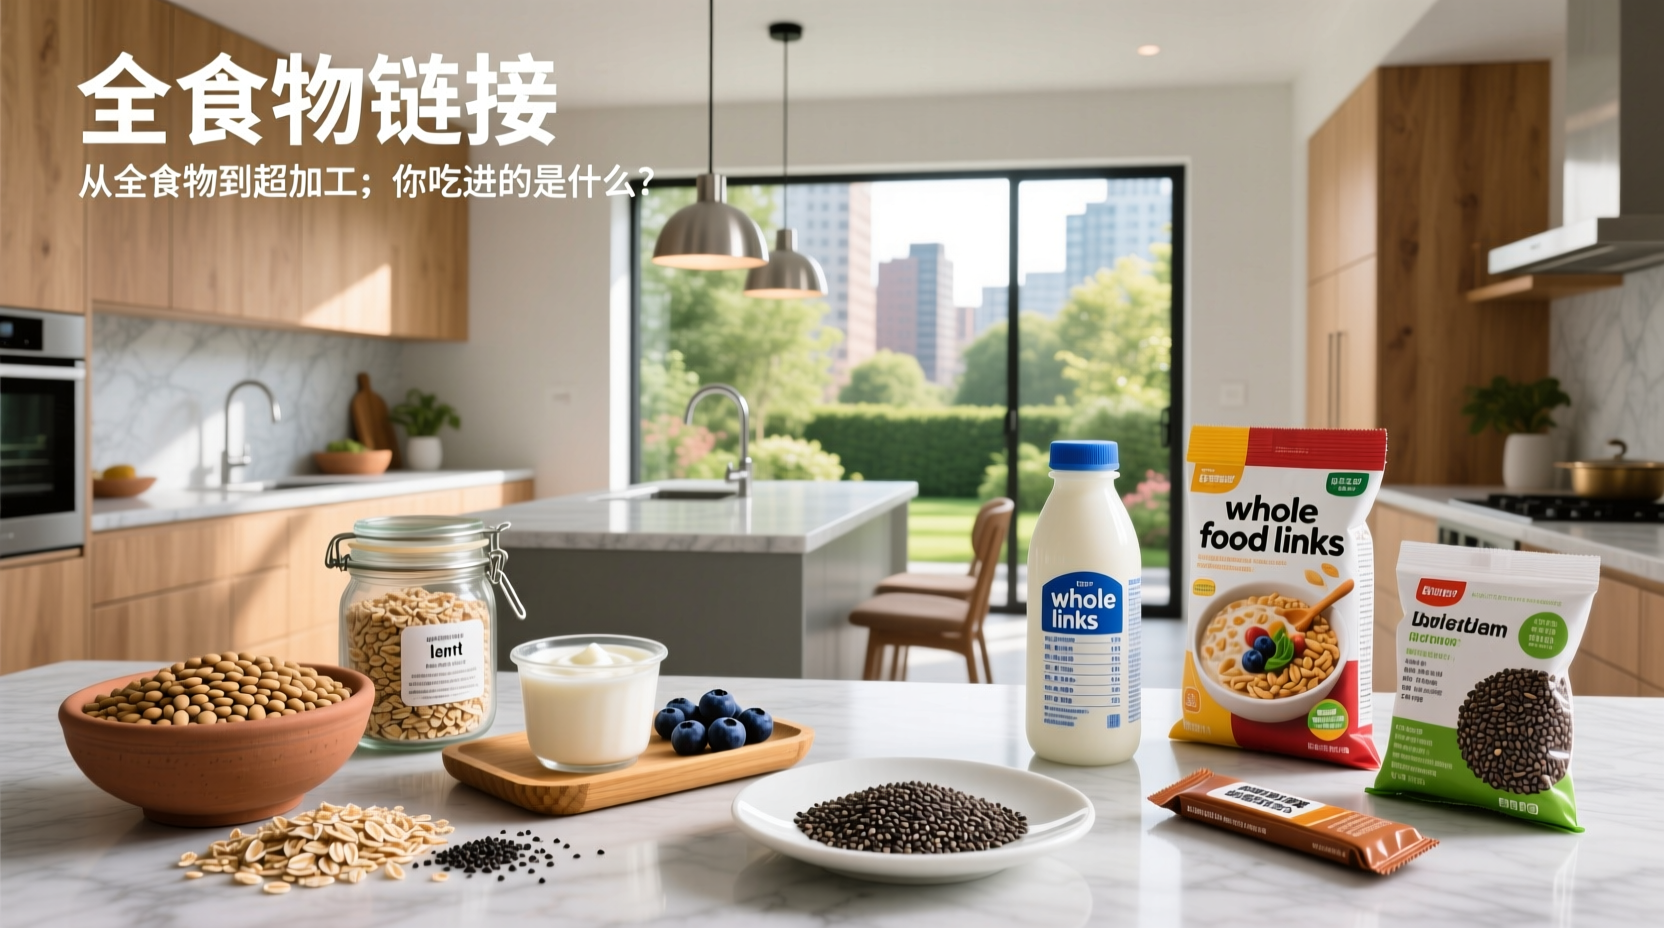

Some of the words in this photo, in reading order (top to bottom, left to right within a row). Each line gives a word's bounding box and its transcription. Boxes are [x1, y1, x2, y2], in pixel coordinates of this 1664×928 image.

[1225, 494, 1319, 524] whole
[1199, 520, 1270, 552] food
[1273, 525, 1345, 557] links
[1051, 587, 1117, 609] whole
[1052, 608, 1099, 630] links
